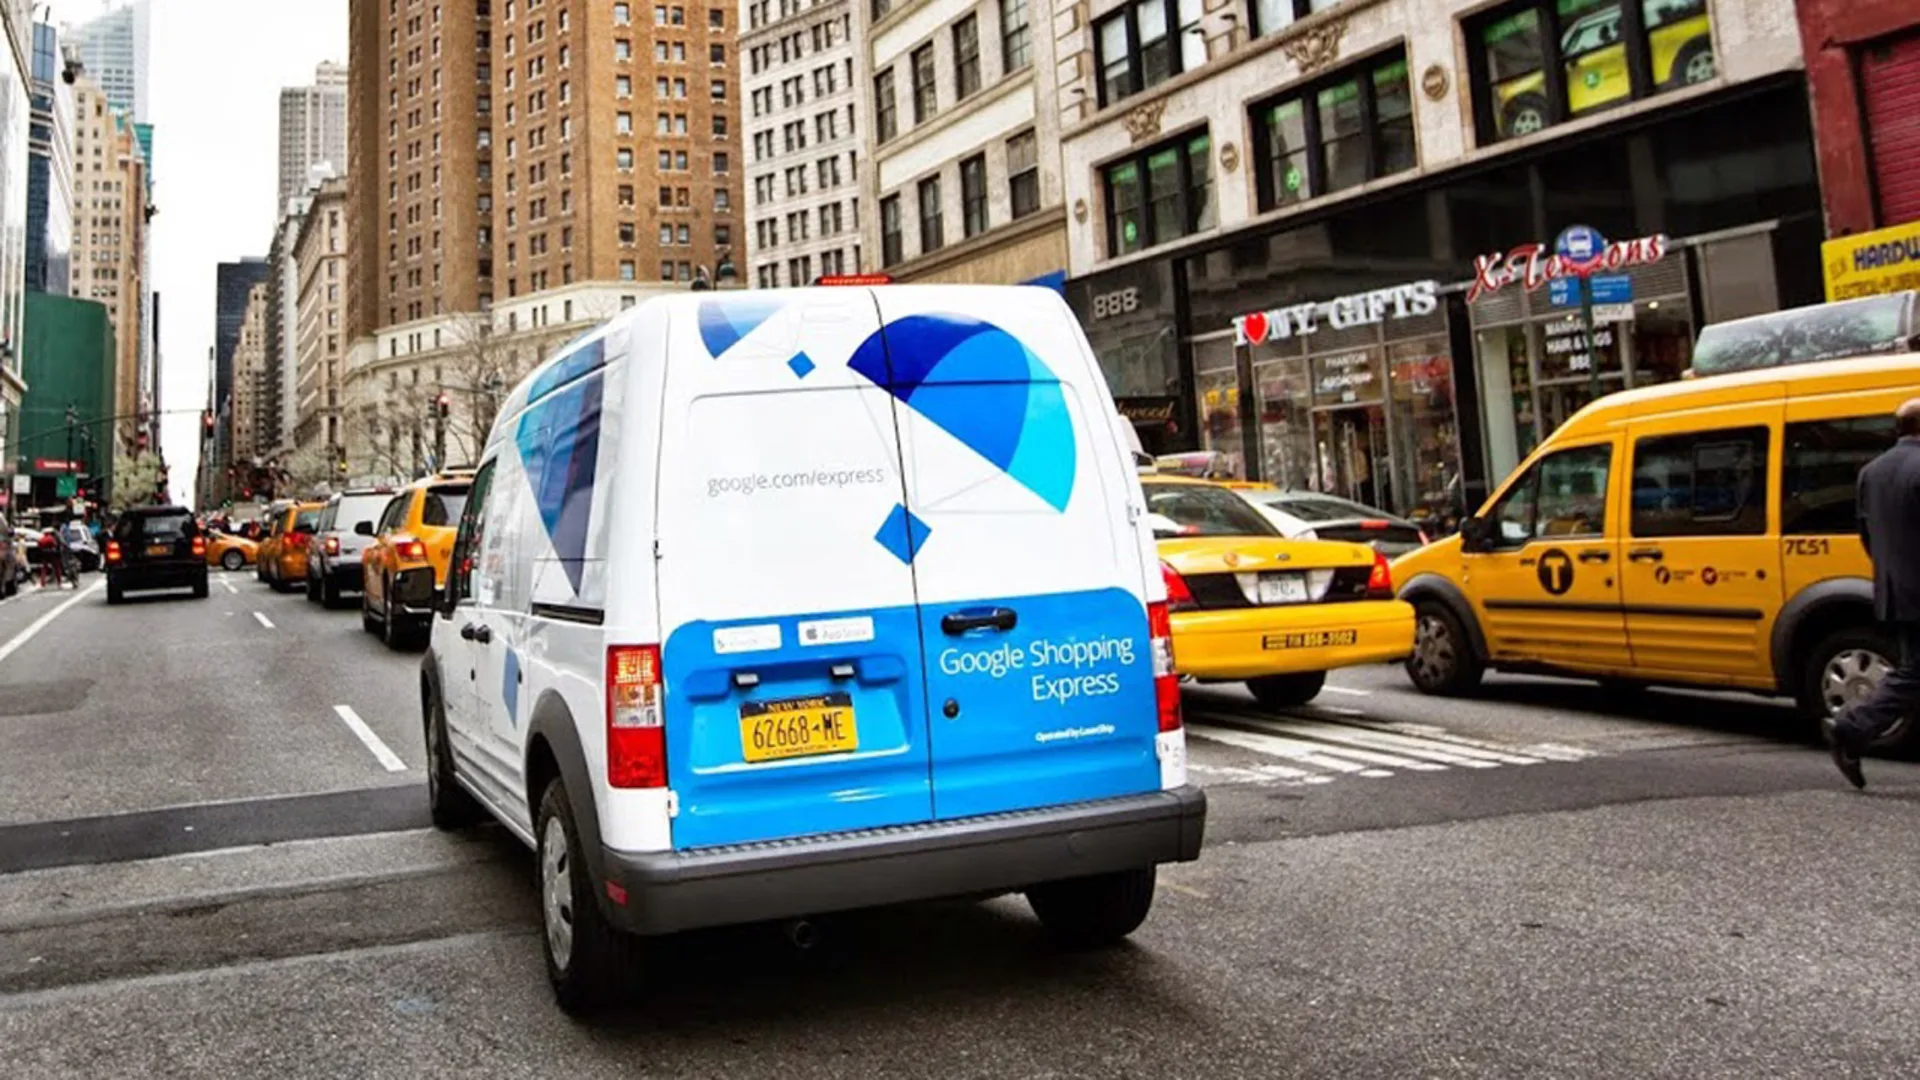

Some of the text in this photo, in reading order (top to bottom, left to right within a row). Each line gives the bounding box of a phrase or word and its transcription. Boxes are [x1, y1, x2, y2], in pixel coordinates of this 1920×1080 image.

[1093, 287, 1138, 318] 888
[1267, 303, 1318, 341] NY
[1329, 279, 1438, 330] GIFTS
[1546, 337, 1572, 354] HAIR
[707, 468, 885, 498] google.com/express
[940, 635, 1136, 677] Google Shopping
[1032, 673, 1120, 705] Express
[753, 710, 846, 750] 62668 ME
